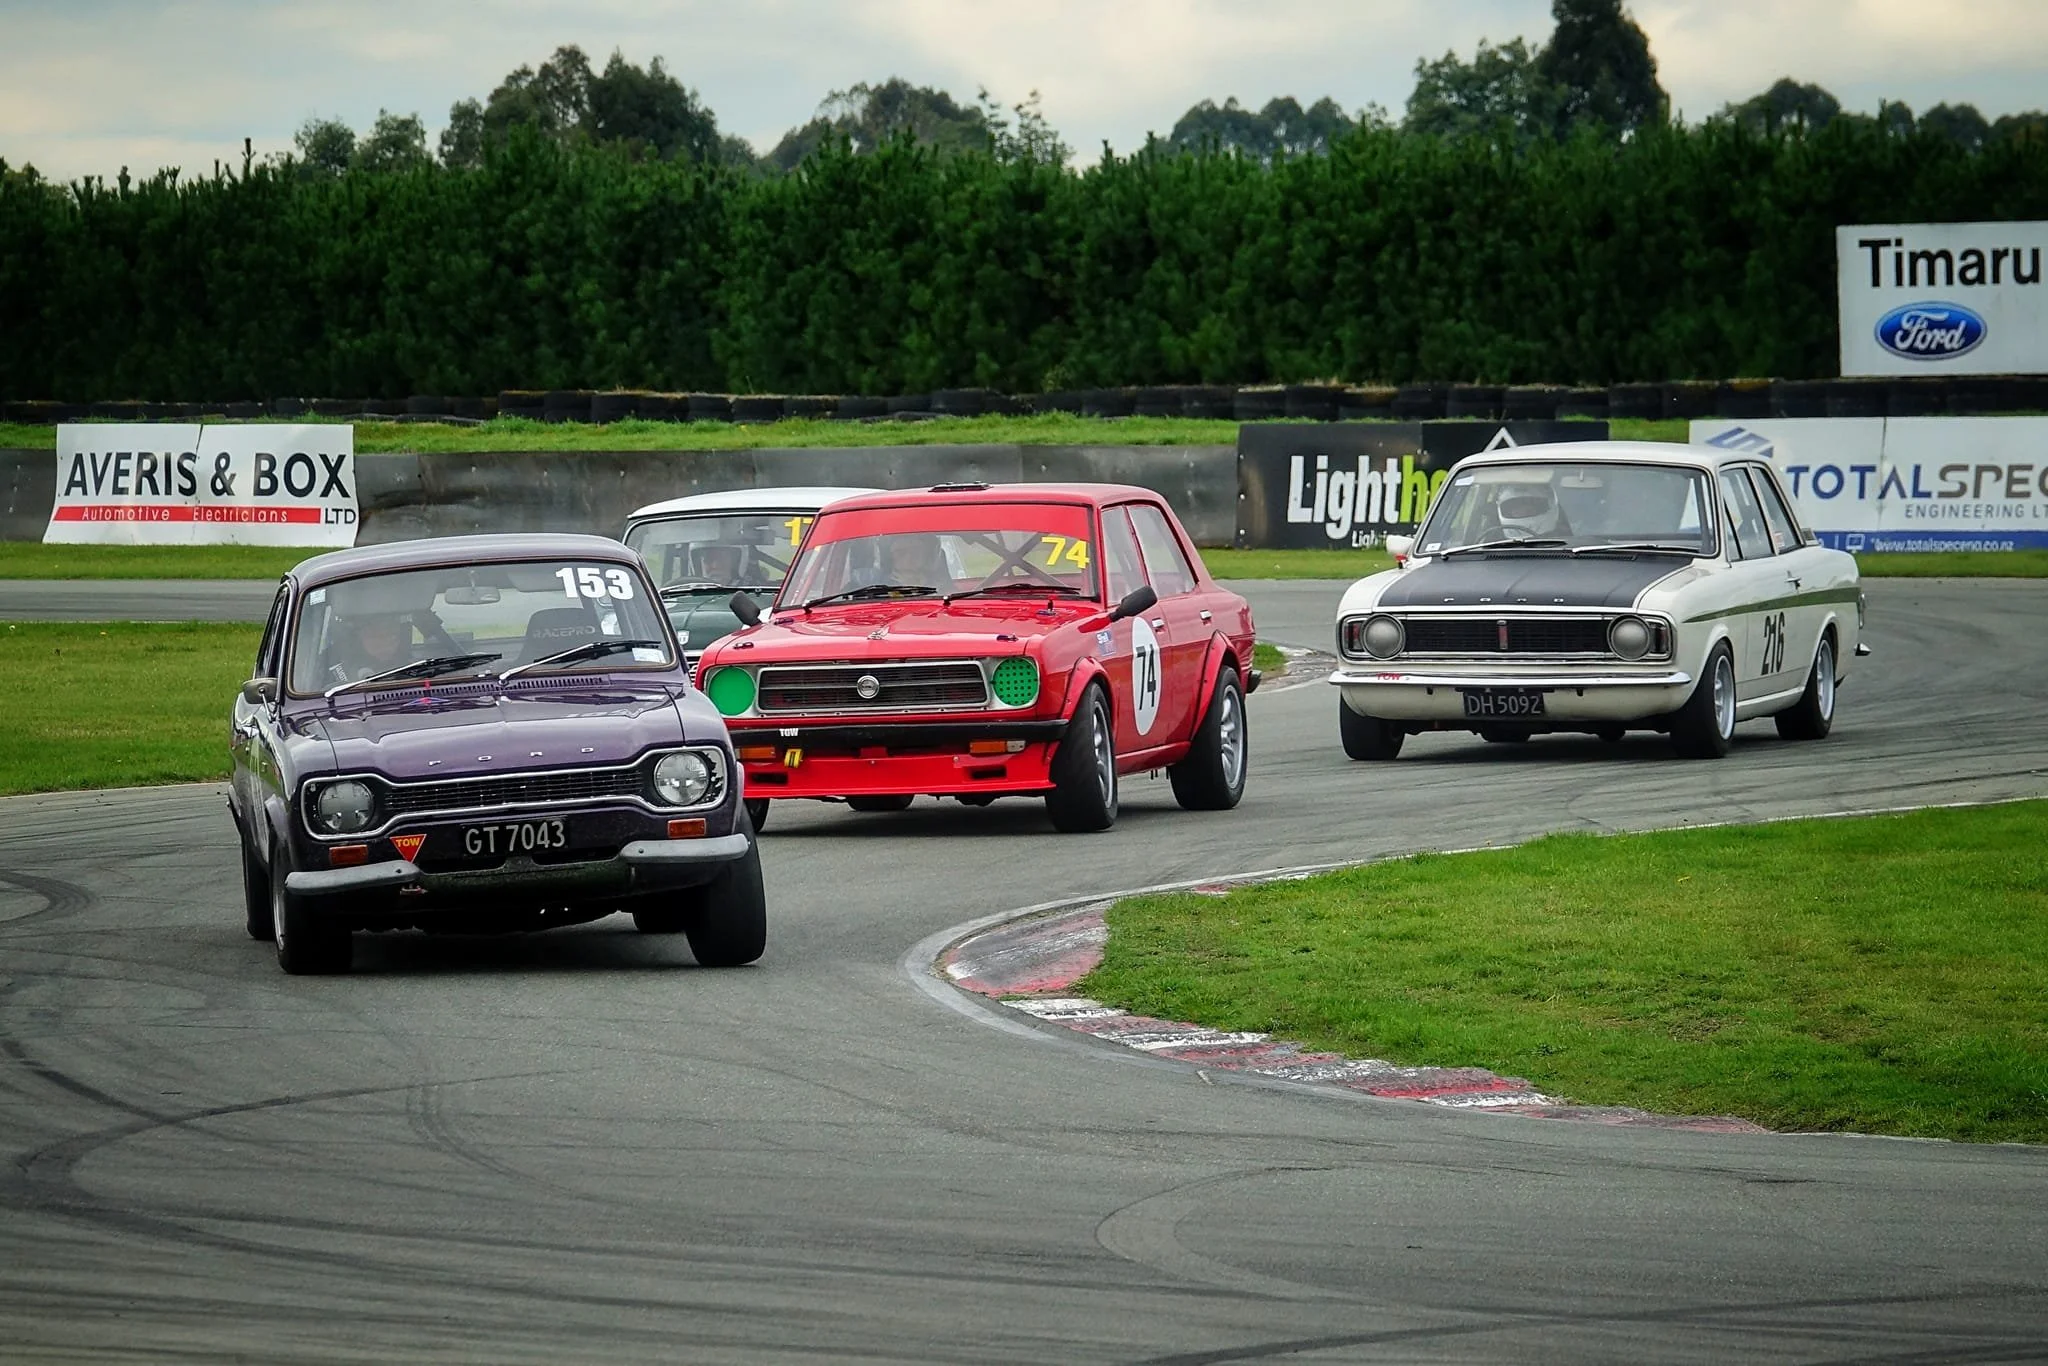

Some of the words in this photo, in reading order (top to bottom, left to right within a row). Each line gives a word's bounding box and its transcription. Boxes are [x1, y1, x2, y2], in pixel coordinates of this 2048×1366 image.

[1858, 238, 2040, 288] Timaru
[1894, 309, 1968, 351] Ford
[64, 451, 197, 497] AVERIS
[210, 451, 236, 496] &
[253, 452, 351, 498] BOX
[82, 507, 170, 521] Automotive
[193, 507, 288, 522] Electricians
[324, 508, 357, 525] LTD
[1904, 503, 2025, 519] ENGINEERING
[784, 516, 815, 547] 1
[1041, 536, 1089, 569] 74
[555, 567, 634, 600] 153
[532, 625, 596, 639] RACEPRO
[1761, 611, 1785, 675] 216
[1135, 643, 1157, 711] 74
[1467, 695, 1494, 715] DH
[1498, 695, 1543, 715] 5092
[779, 727, 799, 737] TOW
[428, 747, 594, 766] FORD
[395, 837, 421, 848] TOW
[465, 826, 500, 855] GT
[505, 820, 566, 852] 7043
